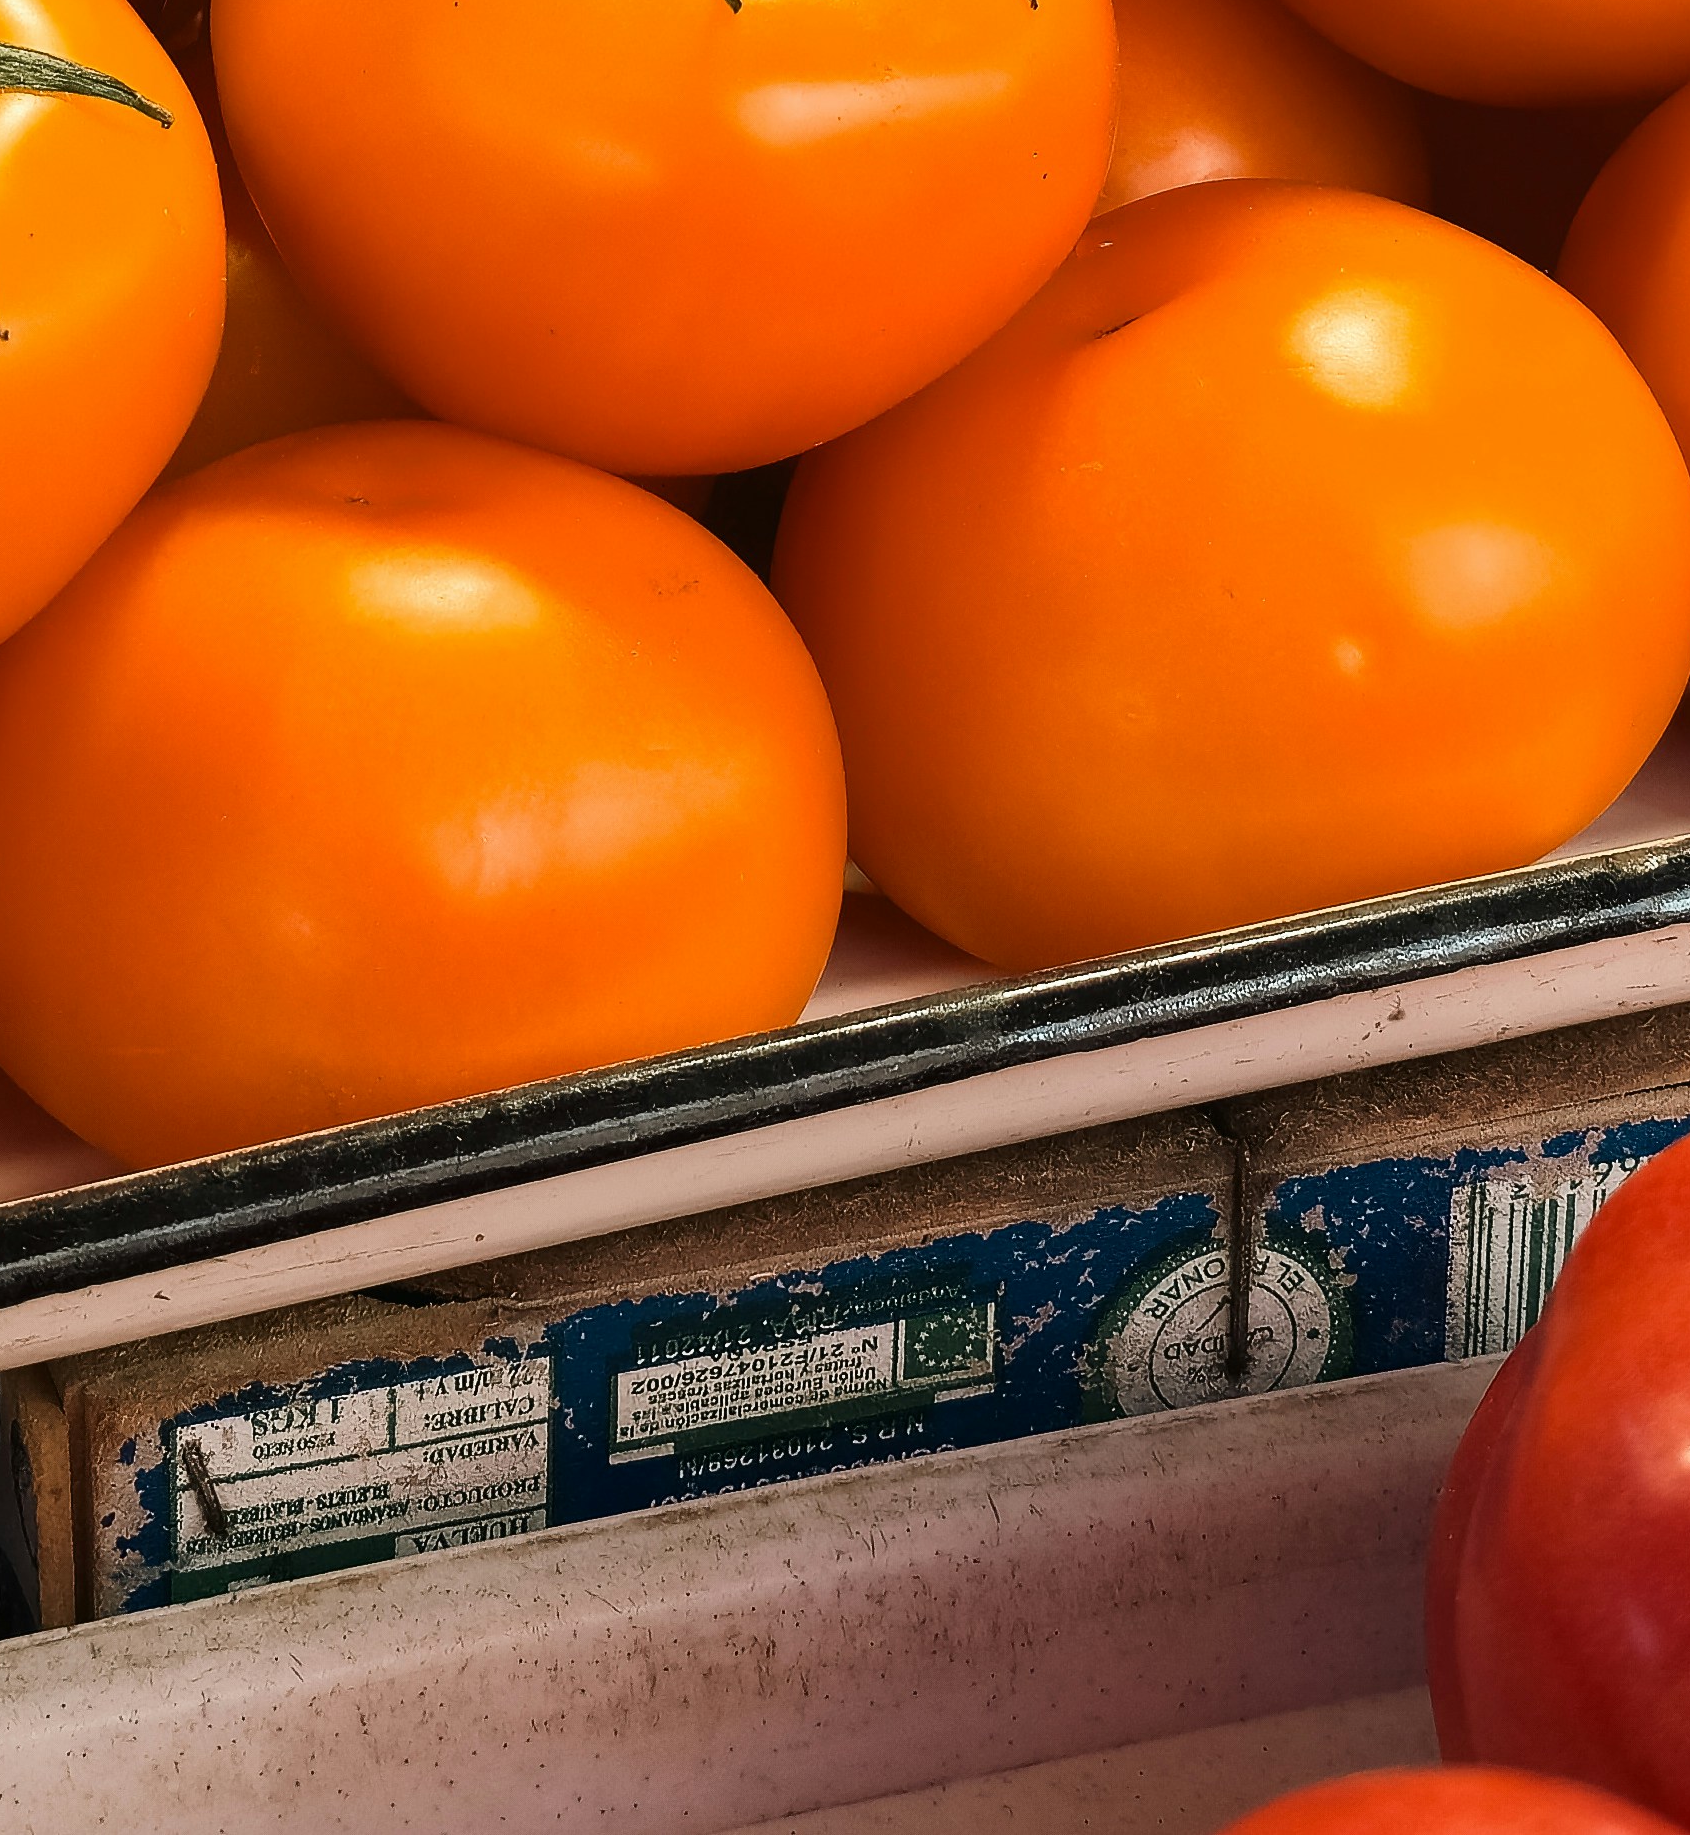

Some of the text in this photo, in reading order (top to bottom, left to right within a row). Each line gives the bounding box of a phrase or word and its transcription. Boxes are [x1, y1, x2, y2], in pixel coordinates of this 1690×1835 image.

[422, 1395, 535, 1432] CALIBRE:
[422, 1430, 538, 1466] VARIEDAD:
[415, 1475, 541, 1513] PRODUCTO:
[411, 1513, 530, 1554] HUELVA
